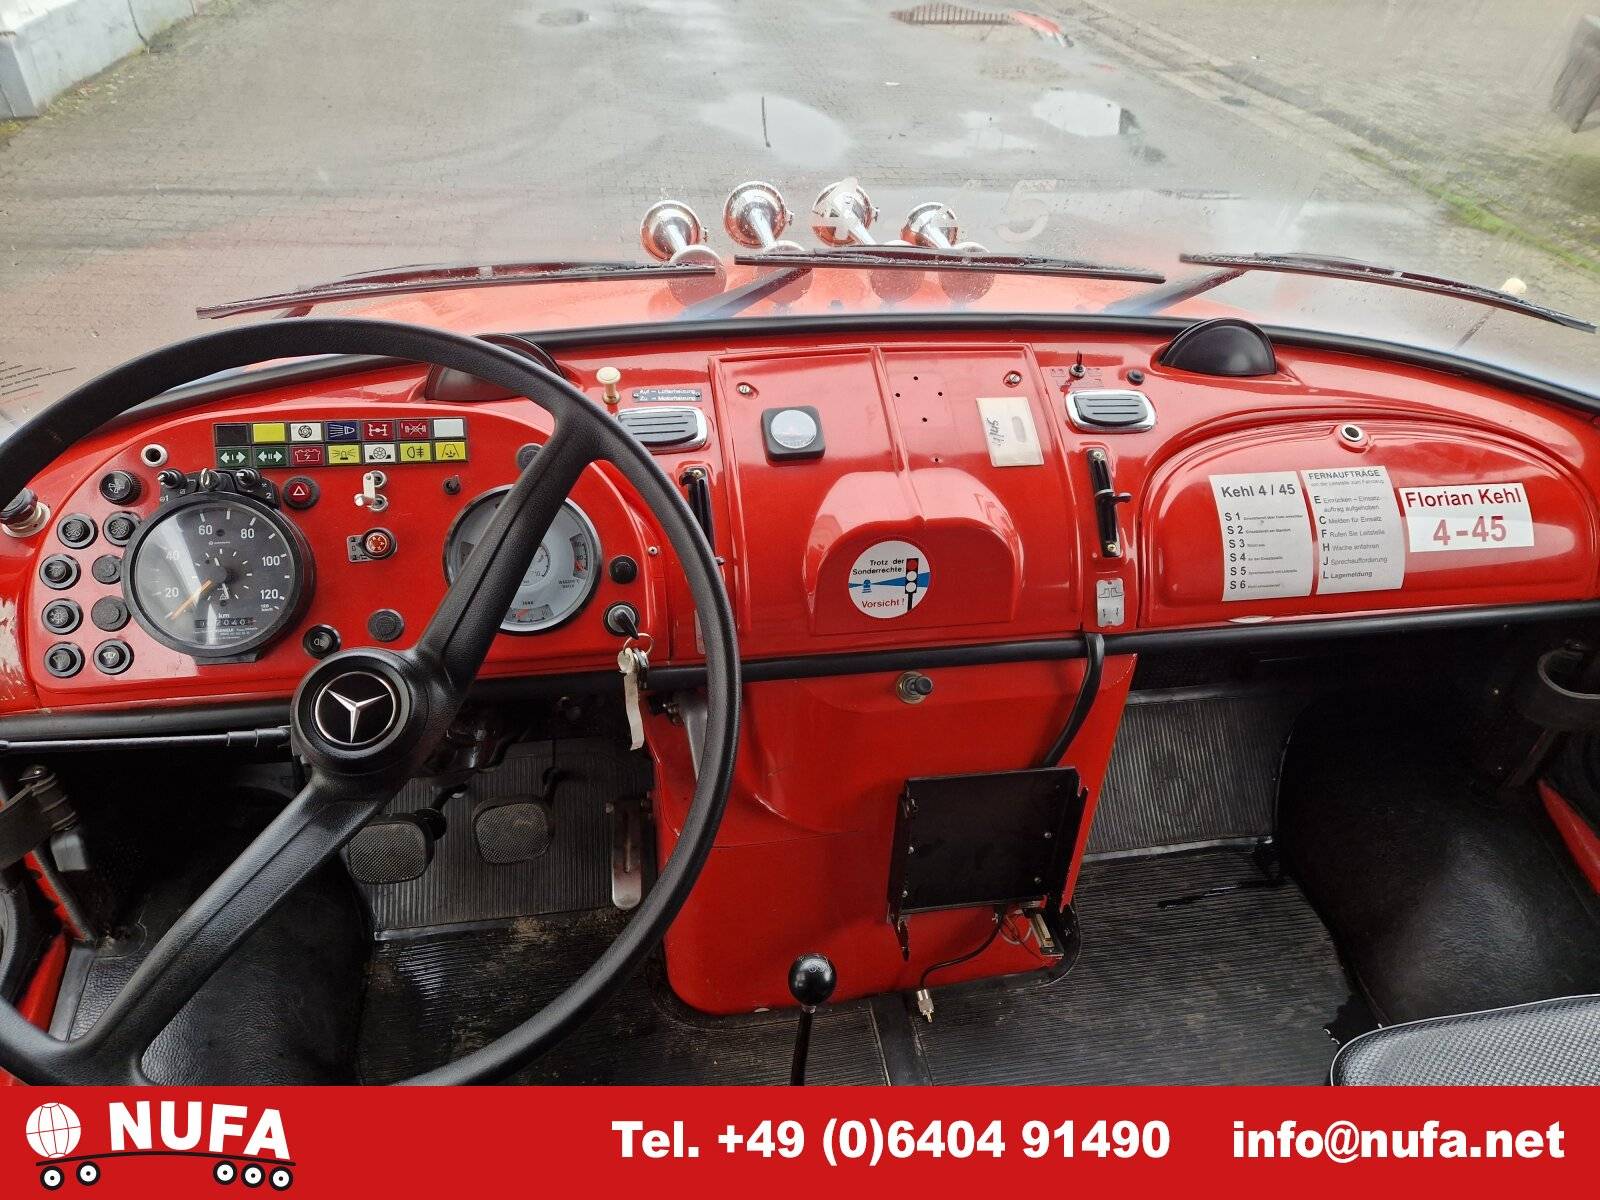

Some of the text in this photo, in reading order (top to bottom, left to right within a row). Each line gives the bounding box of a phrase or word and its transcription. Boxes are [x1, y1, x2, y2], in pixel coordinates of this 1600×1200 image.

[1221, 485, 1255, 498] Kehl
[1258, 485, 1268, 496] 4
[1279, 483, 1296, 495] 45
[1314, 496, 1321, 504] E
[1405, 487, 1522, 508] Florian Kehl
[1225, 512, 1232, 521] S
[1235, 512, 1241, 520] 1
[1319, 516, 1327, 525] C
[199, 525, 213, 535] 60
[241, 528, 255, 539] 80
[1227, 526, 1235, 535] S
[1237, 525, 1244, 534] 2
[1321, 529, 1328, 538] F
[1229, 539, 1236, 549] S
[1239, 539, 1246, 548] 3
[1322, 543, 1330, 552] H
[167, 551, 179, 561] 40
[1230, 553, 1237, 562] S
[1240, 552, 1247, 561] 4
[1323, 556, 1329, 566] J
[262, 556, 281, 567] 100
[870, 558, 905, 567] Trotz der
[852, 566, 903, 576] Sonderrechte
[1230, 566, 1237, 576] S
[1240, 566, 1247, 576] 5
[1323, 570, 1329, 579] L
[1229, 580, 1237, 590] S
[1240, 580, 1246, 589] 6
[165, 587, 179, 598] 20
[260, 589, 278, 599] 120
[861, 599, 901, 608] Vorsicht
